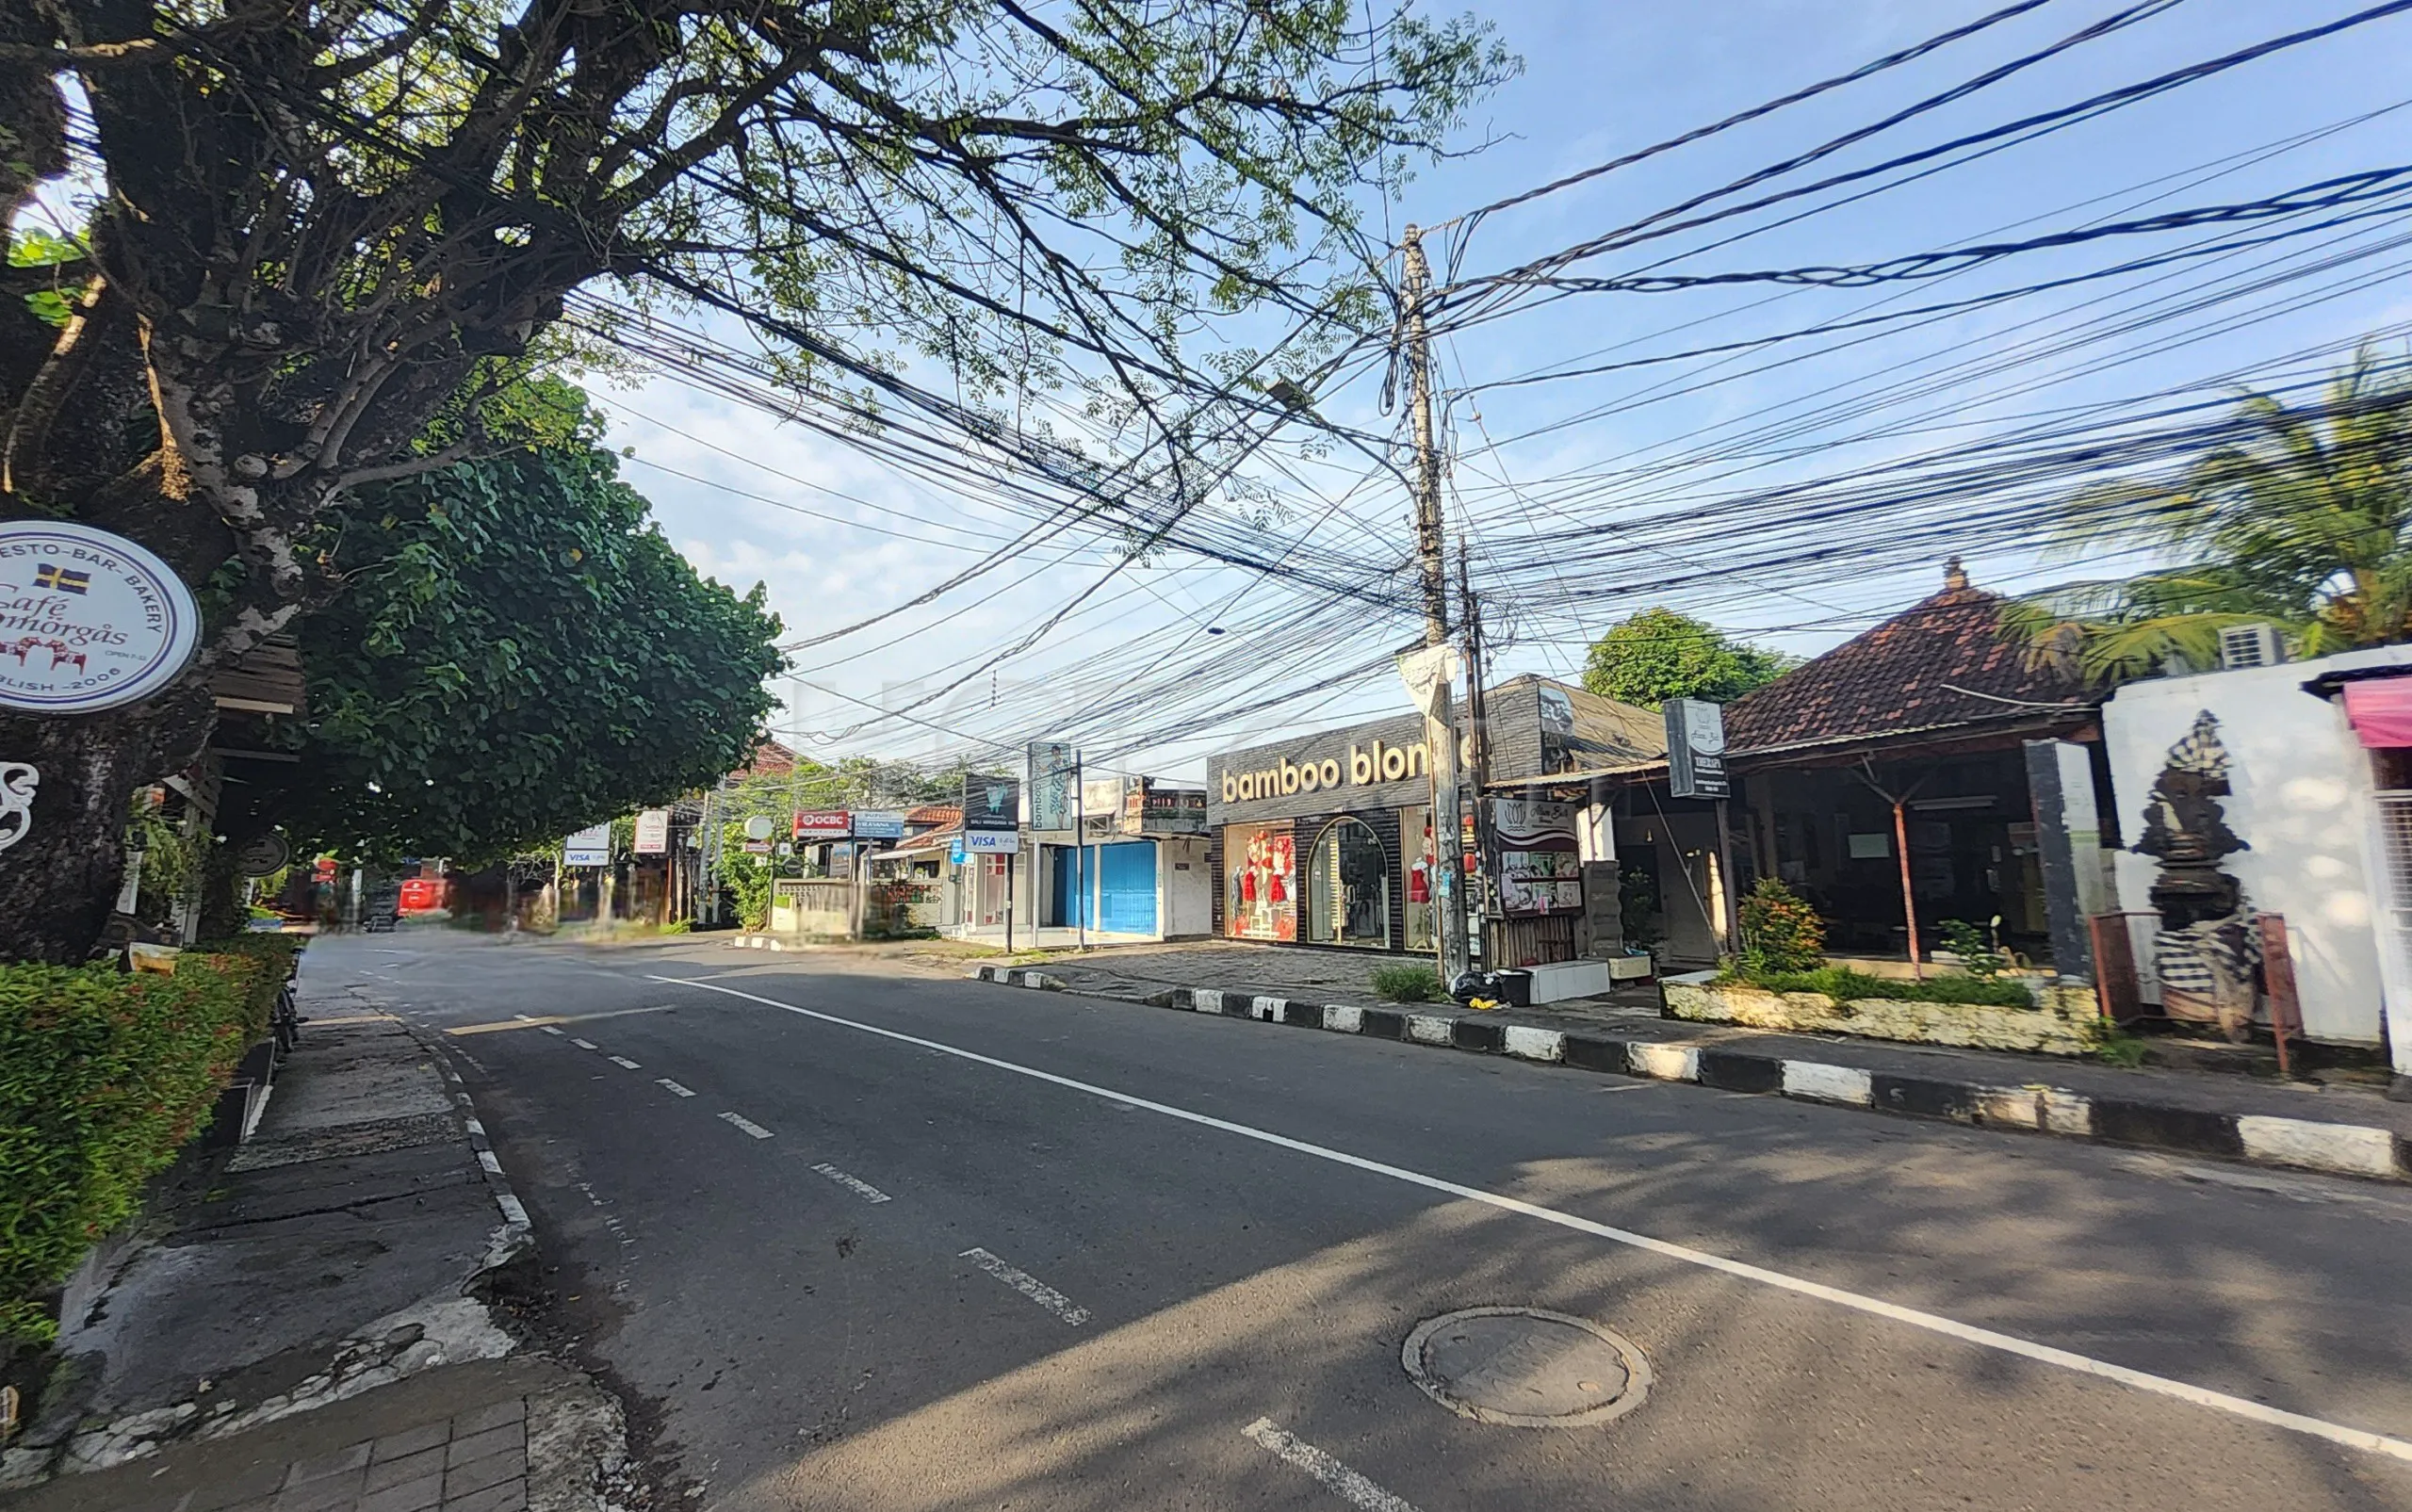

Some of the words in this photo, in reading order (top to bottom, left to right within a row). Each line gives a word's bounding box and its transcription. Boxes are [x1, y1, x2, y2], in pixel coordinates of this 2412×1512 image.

[123, 575, 162, 633] BAKERY
[0, 613, 128, 646] mörgås
[1222, 757, 1342, 804] bamboo
[1349, 733, 1481, 786] blone
[815, 816, 843, 824] OCBC
[1034, 783, 1042, 828] bamboo
[969, 836, 997, 847] VISA
